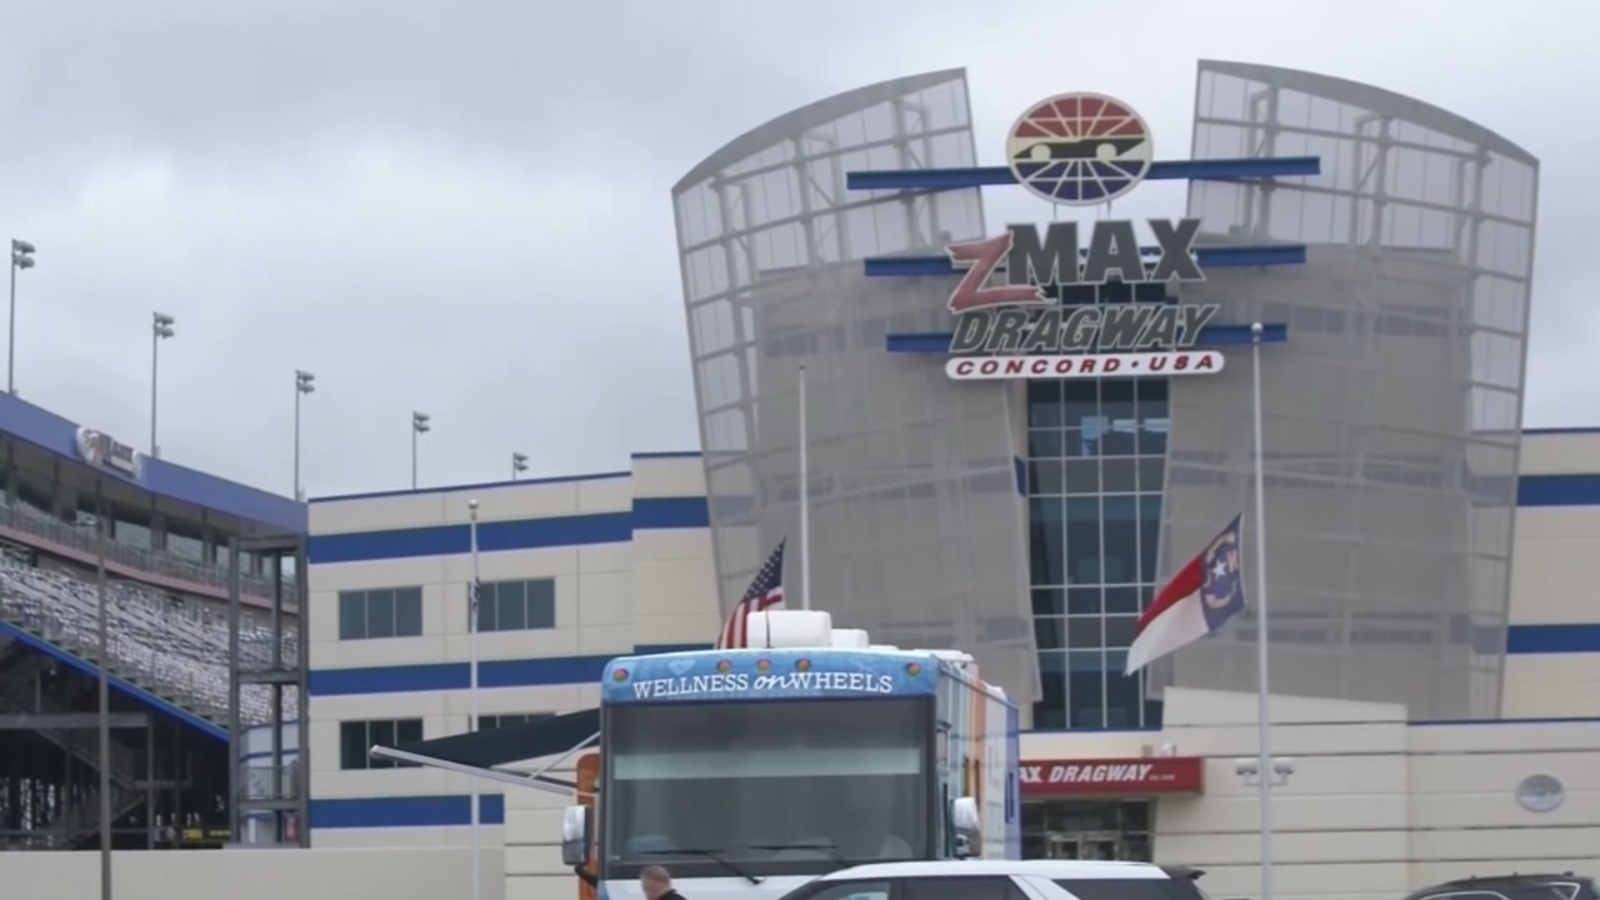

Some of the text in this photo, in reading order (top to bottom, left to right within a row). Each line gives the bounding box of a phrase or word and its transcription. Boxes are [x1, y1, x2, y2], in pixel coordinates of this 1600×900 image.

[949, 304, 1220, 353] DRAGWAY
[956, 355, 1213, 376] CONCORD USA
[633, 672, 893, 699] WELLNESS on WHEELS
[1049, 764, 1153, 783] DRAGWAY
